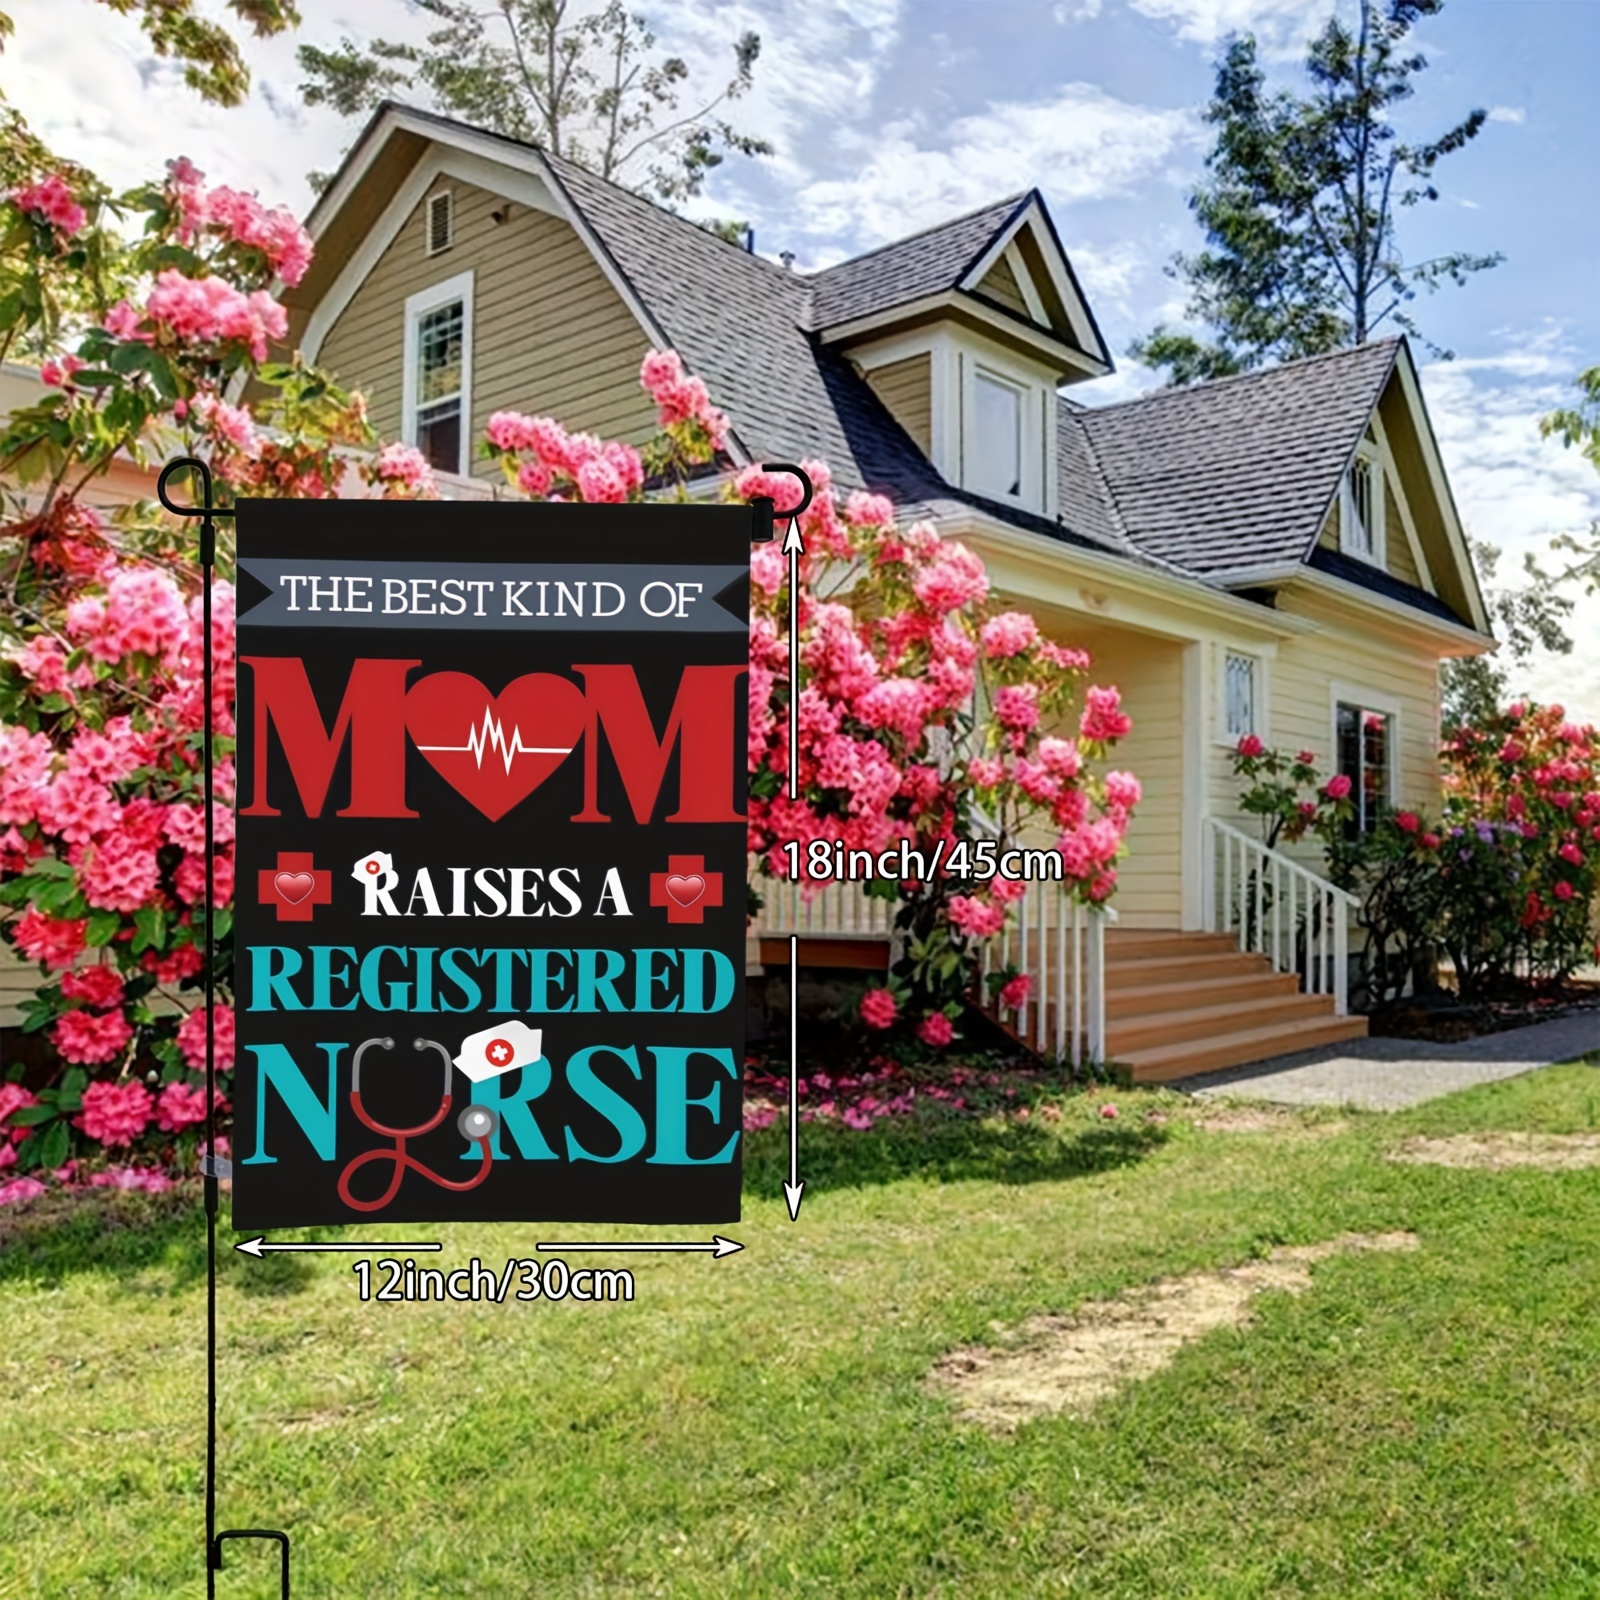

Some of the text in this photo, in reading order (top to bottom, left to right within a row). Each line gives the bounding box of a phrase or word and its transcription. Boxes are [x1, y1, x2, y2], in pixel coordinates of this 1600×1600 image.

[279, 574, 704, 619] THE BEST KIND OF
[357, 863, 634, 919] RAISES A
[245, 944, 737, 1015] REGISTERED
[241, 1036, 741, 1167] NURSE
